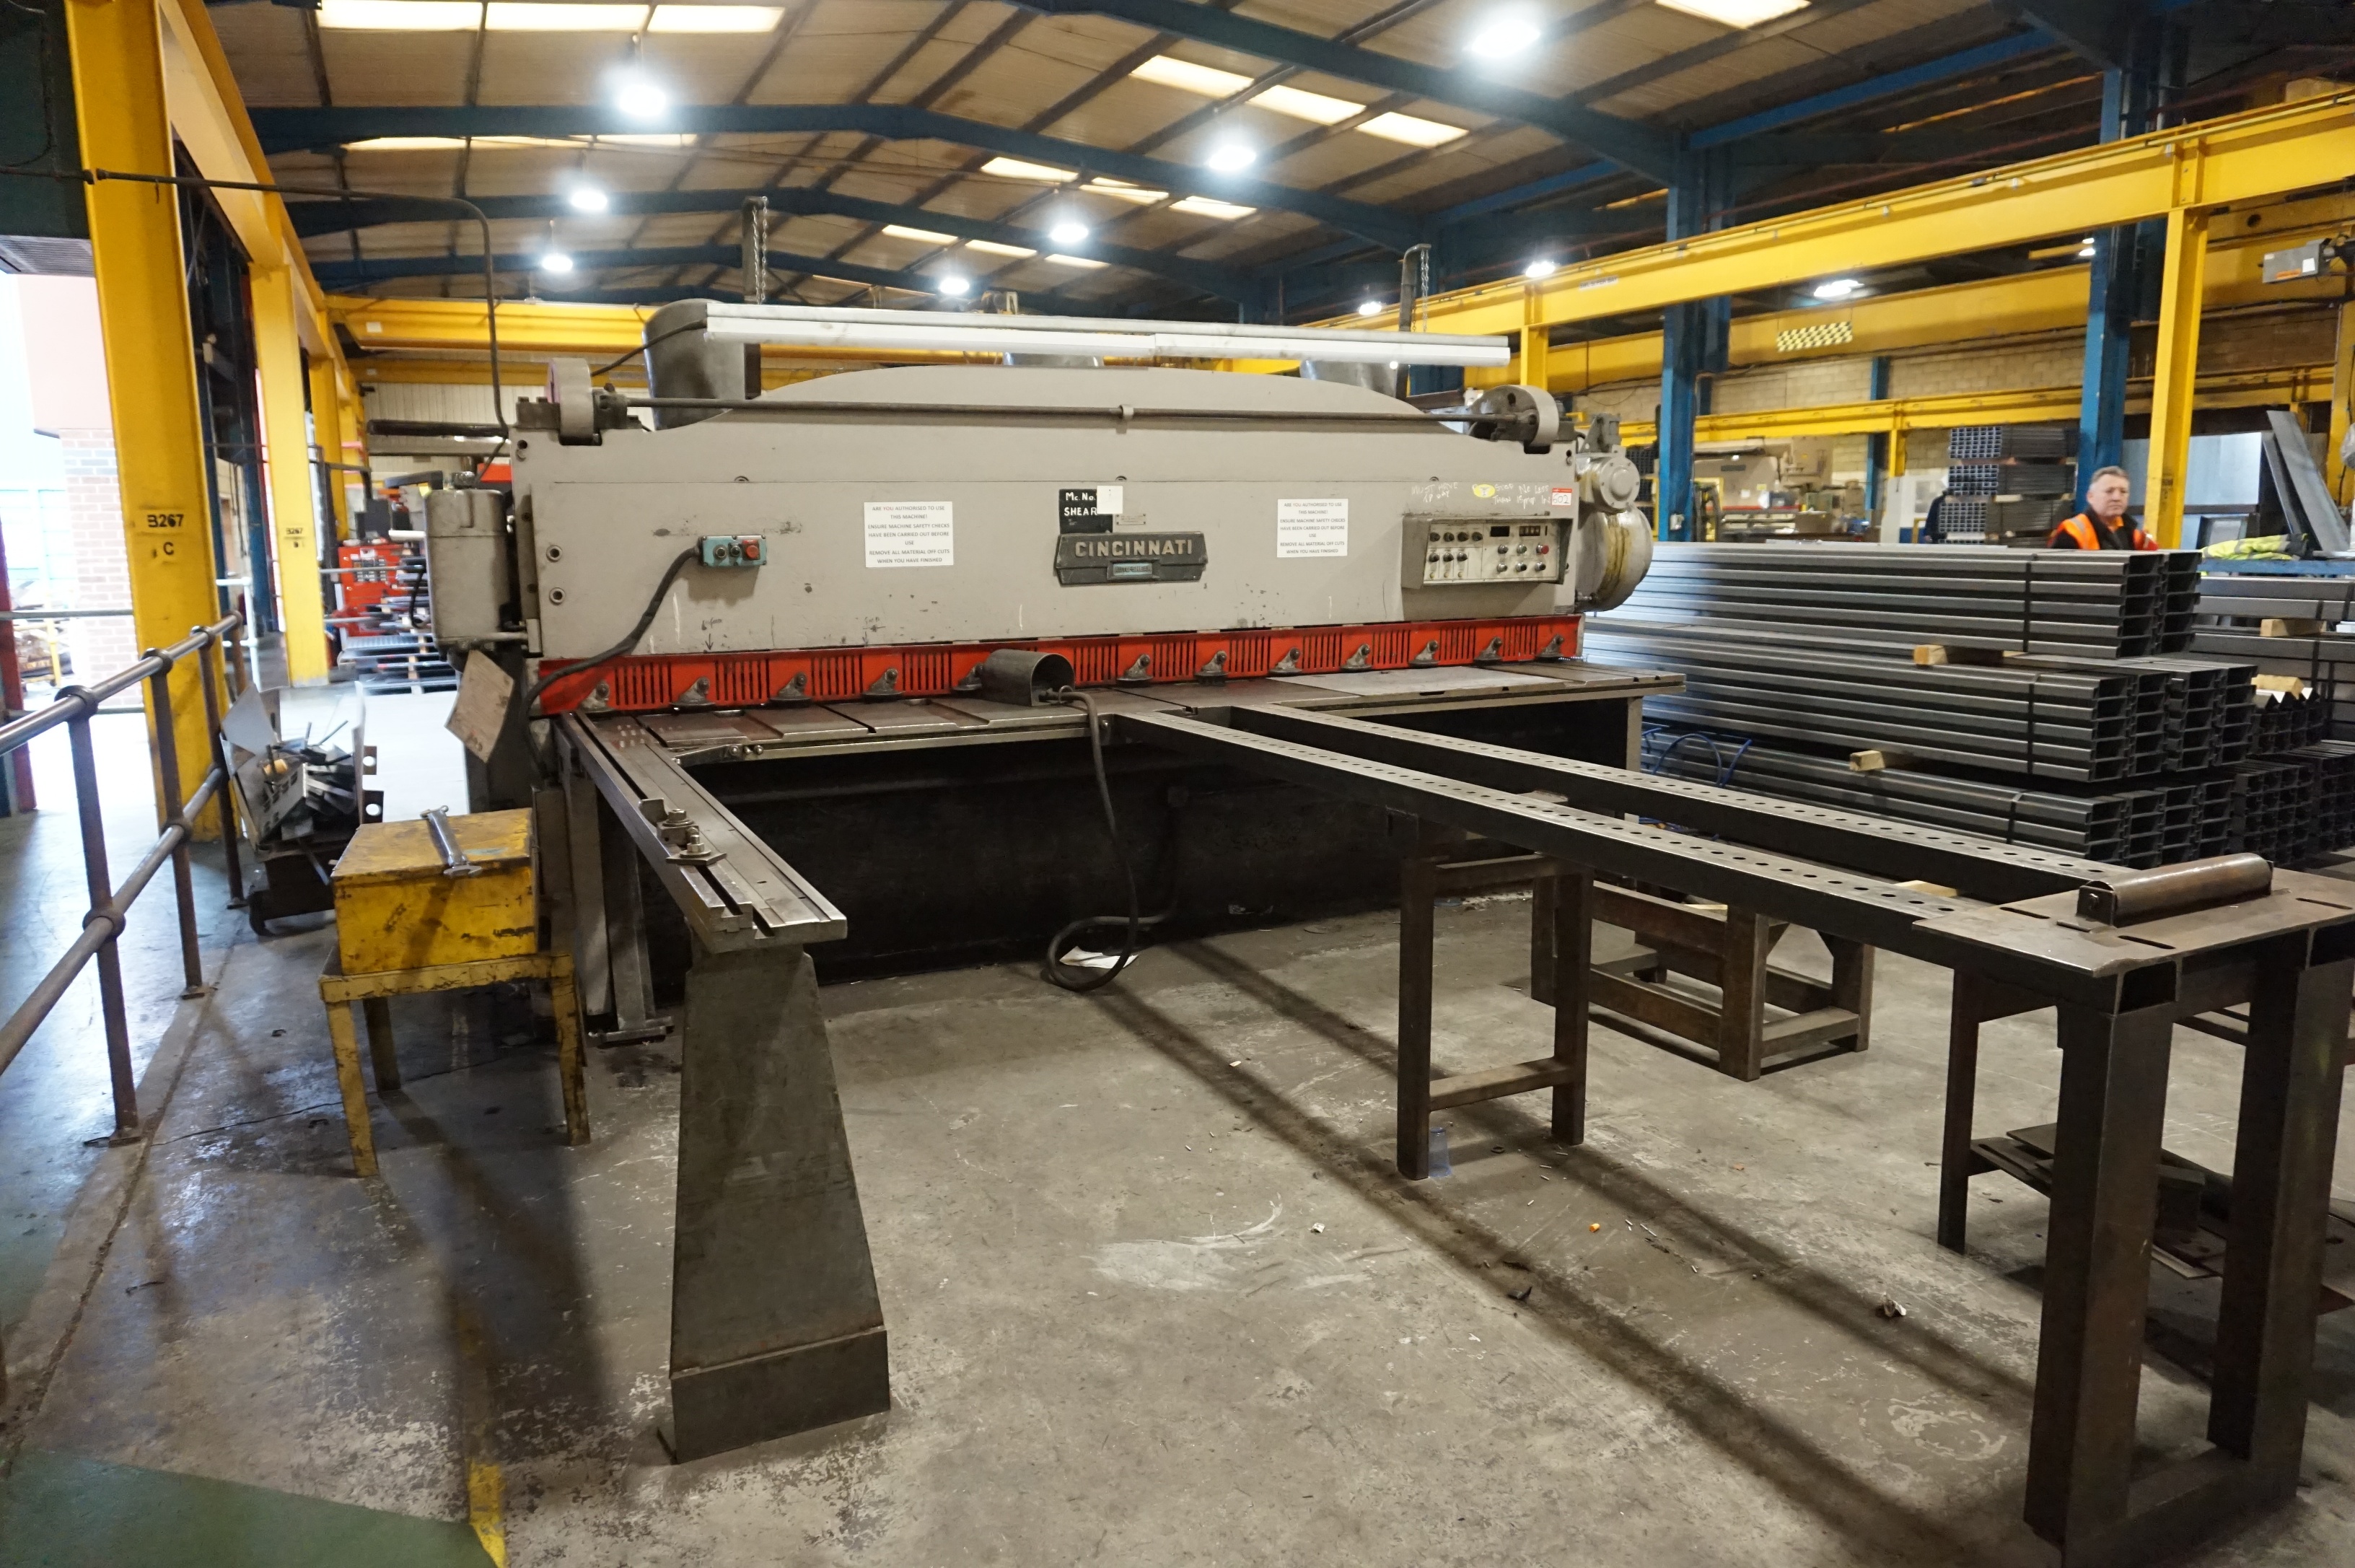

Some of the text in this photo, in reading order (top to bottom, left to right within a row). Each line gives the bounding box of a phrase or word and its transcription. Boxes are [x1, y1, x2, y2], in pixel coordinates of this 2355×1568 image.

[1064, 507, 1097, 516] SHEAR
[147, 514, 184, 527] B267
[163, 542, 175, 556] C
[1075, 539, 1192, 557] CINCINNATI
